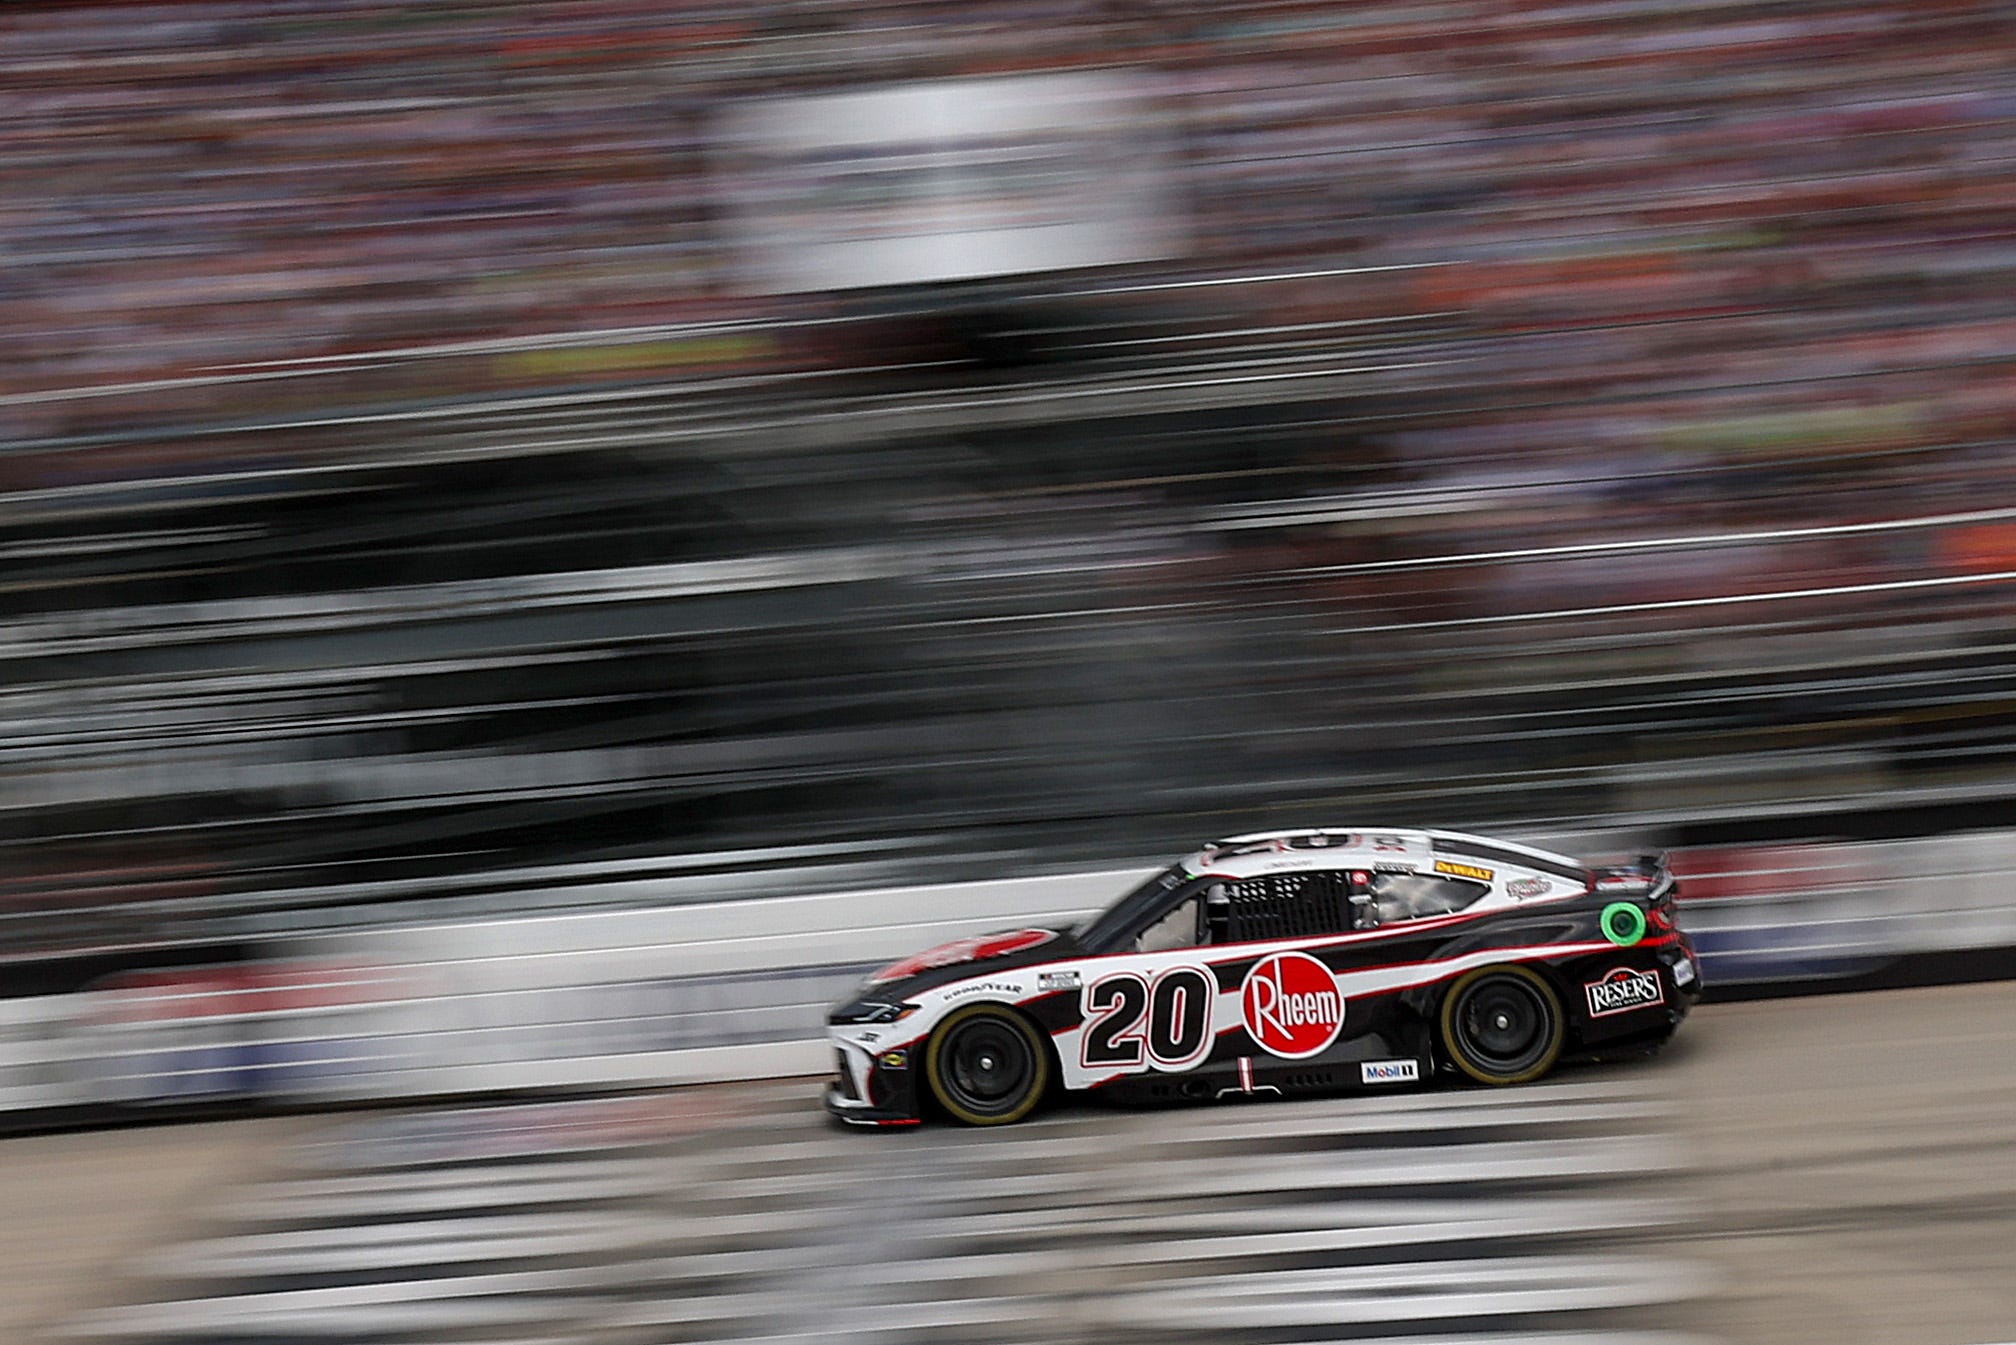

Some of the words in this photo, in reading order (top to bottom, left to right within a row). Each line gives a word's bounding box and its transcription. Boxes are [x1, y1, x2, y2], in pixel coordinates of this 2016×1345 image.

[1081, 965, 1213, 1067] 20
[1251, 957, 1338, 1041] Rheem
[1366, 1065, 1400, 1078] Mobil
